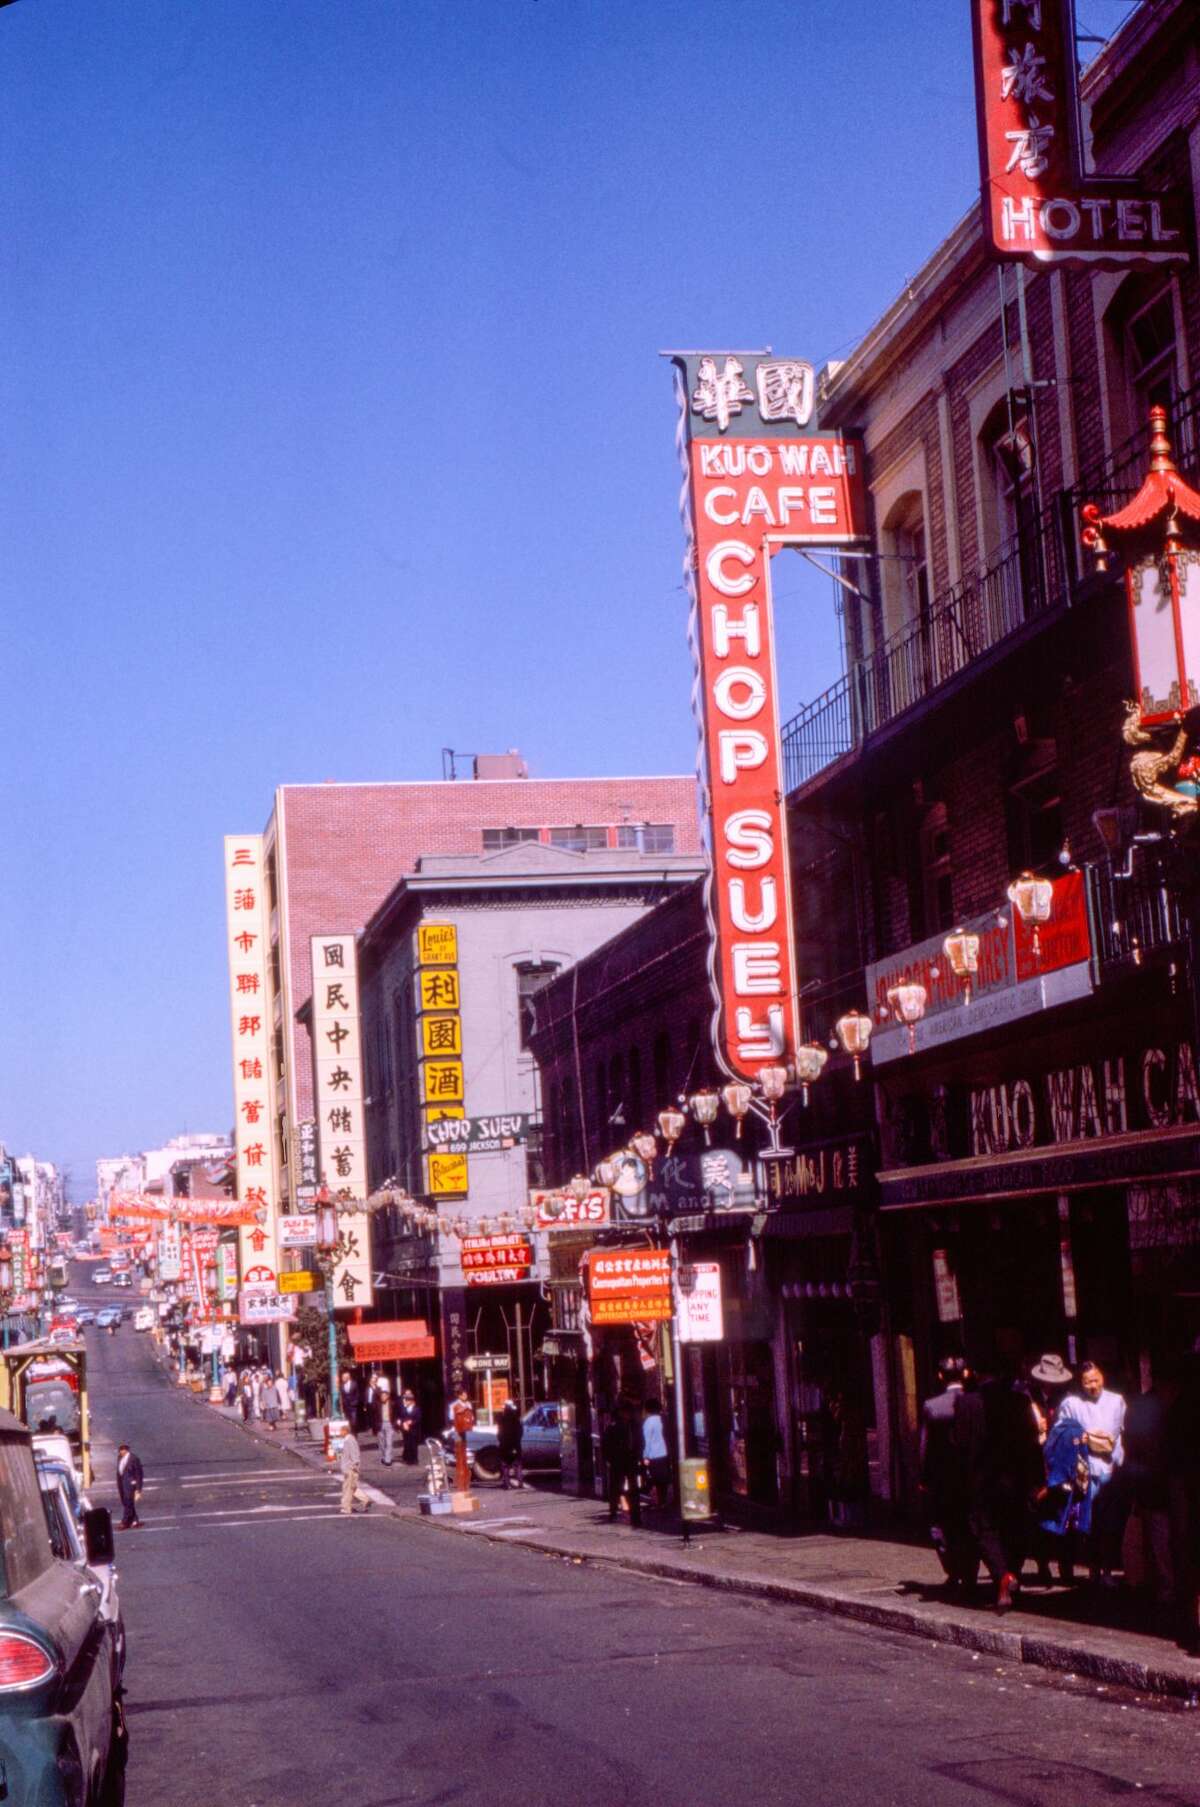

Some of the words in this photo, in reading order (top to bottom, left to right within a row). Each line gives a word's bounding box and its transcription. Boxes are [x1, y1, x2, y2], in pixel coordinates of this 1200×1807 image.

[1002, 196, 1181, 241] HOTEL
[701, 443, 771, 478] KUO
[778, 443, 857, 476] WAH
[704, 486, 837, 526] CAFE
[706, 540, 769, 785] CHOP
[723, 808, 785, 1062] SUEY
[970, 1079, 1035, 1156] KUO
[1047, 1057, 1128, 1144] WAH
[428, 1120, 471, 1145] CHOP
[477, 1115, 522, 1140] SUEY
[466, 1266, 519, 1283] POULTRY
[689, 1302, 710, 1312] ANY
[689, 1313, 711, 1322] TIME
[477, 1359, 492, 1369] ONE
[493, 1358, 508, 1368] WAY
